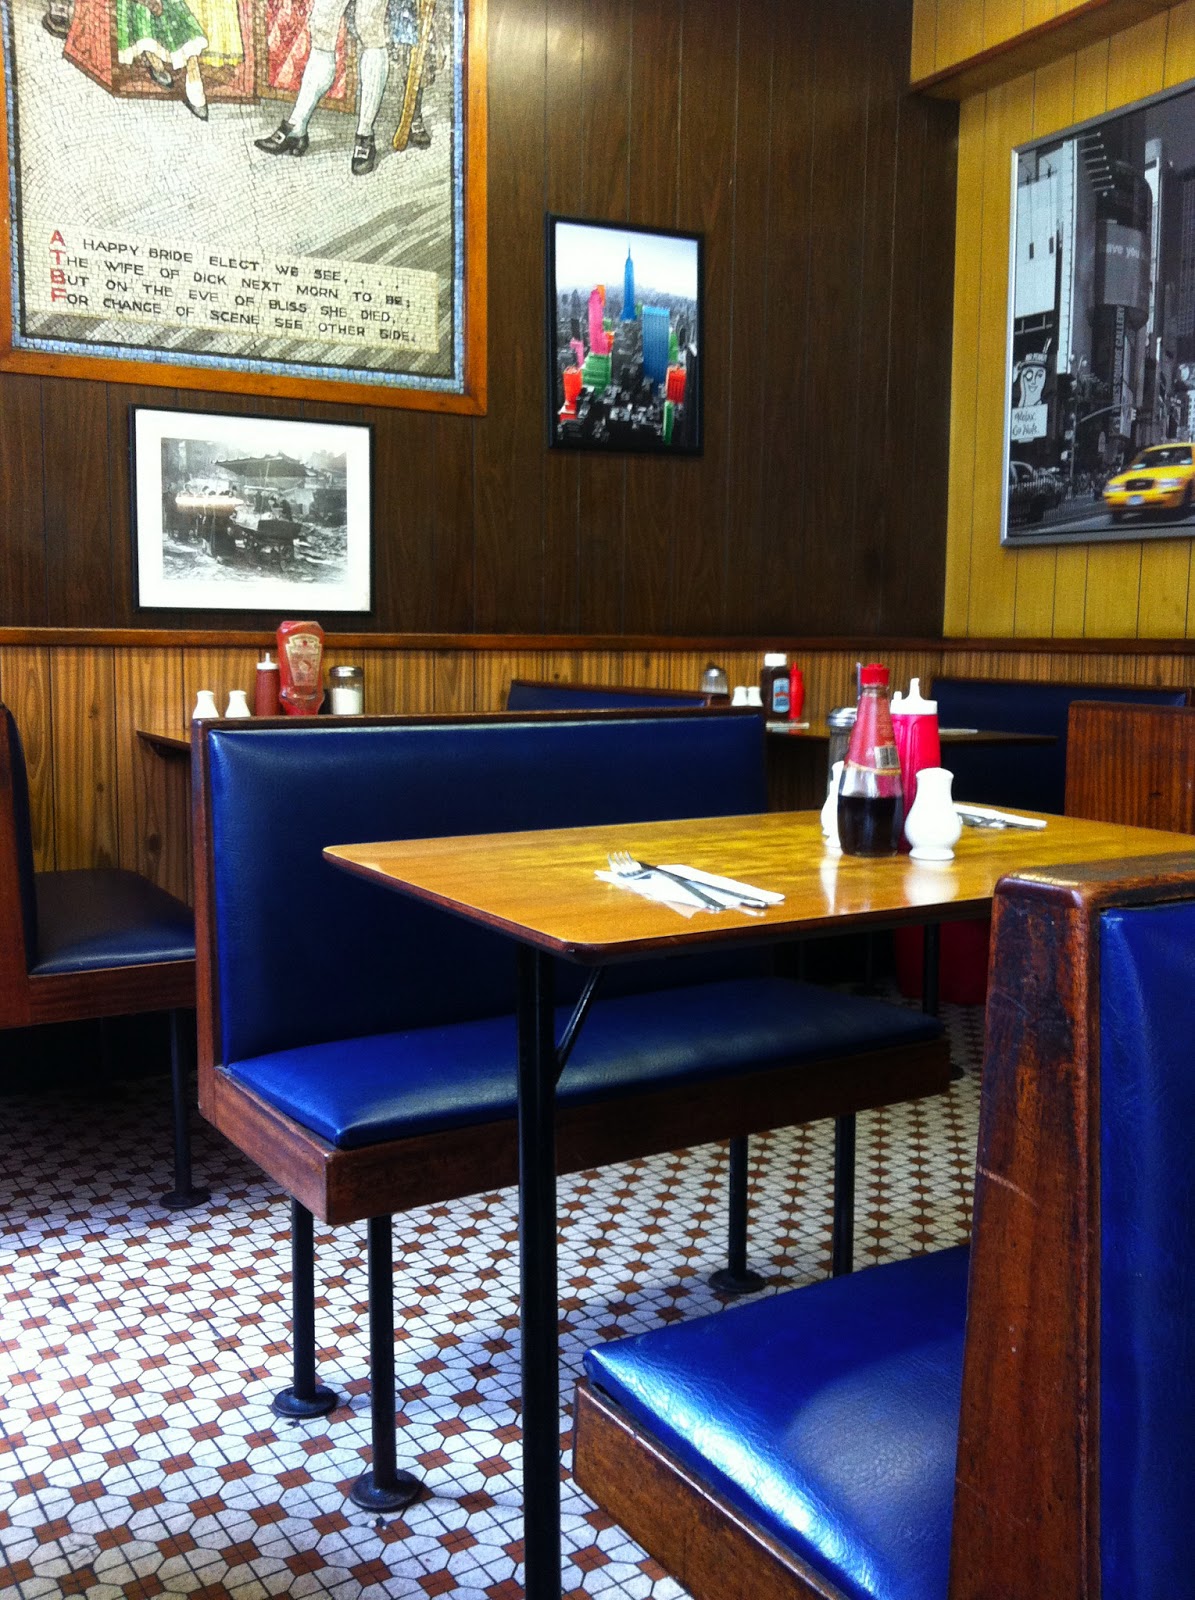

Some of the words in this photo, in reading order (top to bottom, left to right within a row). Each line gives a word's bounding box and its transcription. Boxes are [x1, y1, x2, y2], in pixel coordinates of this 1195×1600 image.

[50, 229, 66, 247] A
[83, 238, 139, 256] HAPPY
[150, 248, 193, 263] BRIDE
[209, 256, 260, 272] ELECT
[275, 265, 299, 277] WE
[50, 249, 89, 268] THE
[104, 260, 144, 276] WIFE
[160, 268, 180, 280] OF
[193, 272, 228, 286] DICK
[241, 278, 282, 292] NEXT
[296, 285, 339, 299] MORN
[353, 291, 372, 303] TO
[50, 268, 89, 287] BUT
[105, 279, 128, 292] ON
[143, 284, 173, 298] THE
[188, 289, 218, 302] EVE
[234, 296, 255, 307] OF
[269, 300, 307, 314] BLISS
[320, 306, 348, 318] SHE
[50, 287, 89, 307] FOR
[103, 298, 162, 315] CHANGE
[176, 306, 195, 318] OF
[209, 310, 260, 326] SCENE
[274, 318, 304, 330] SEE
[318, 323, 366, 337] OTHER
